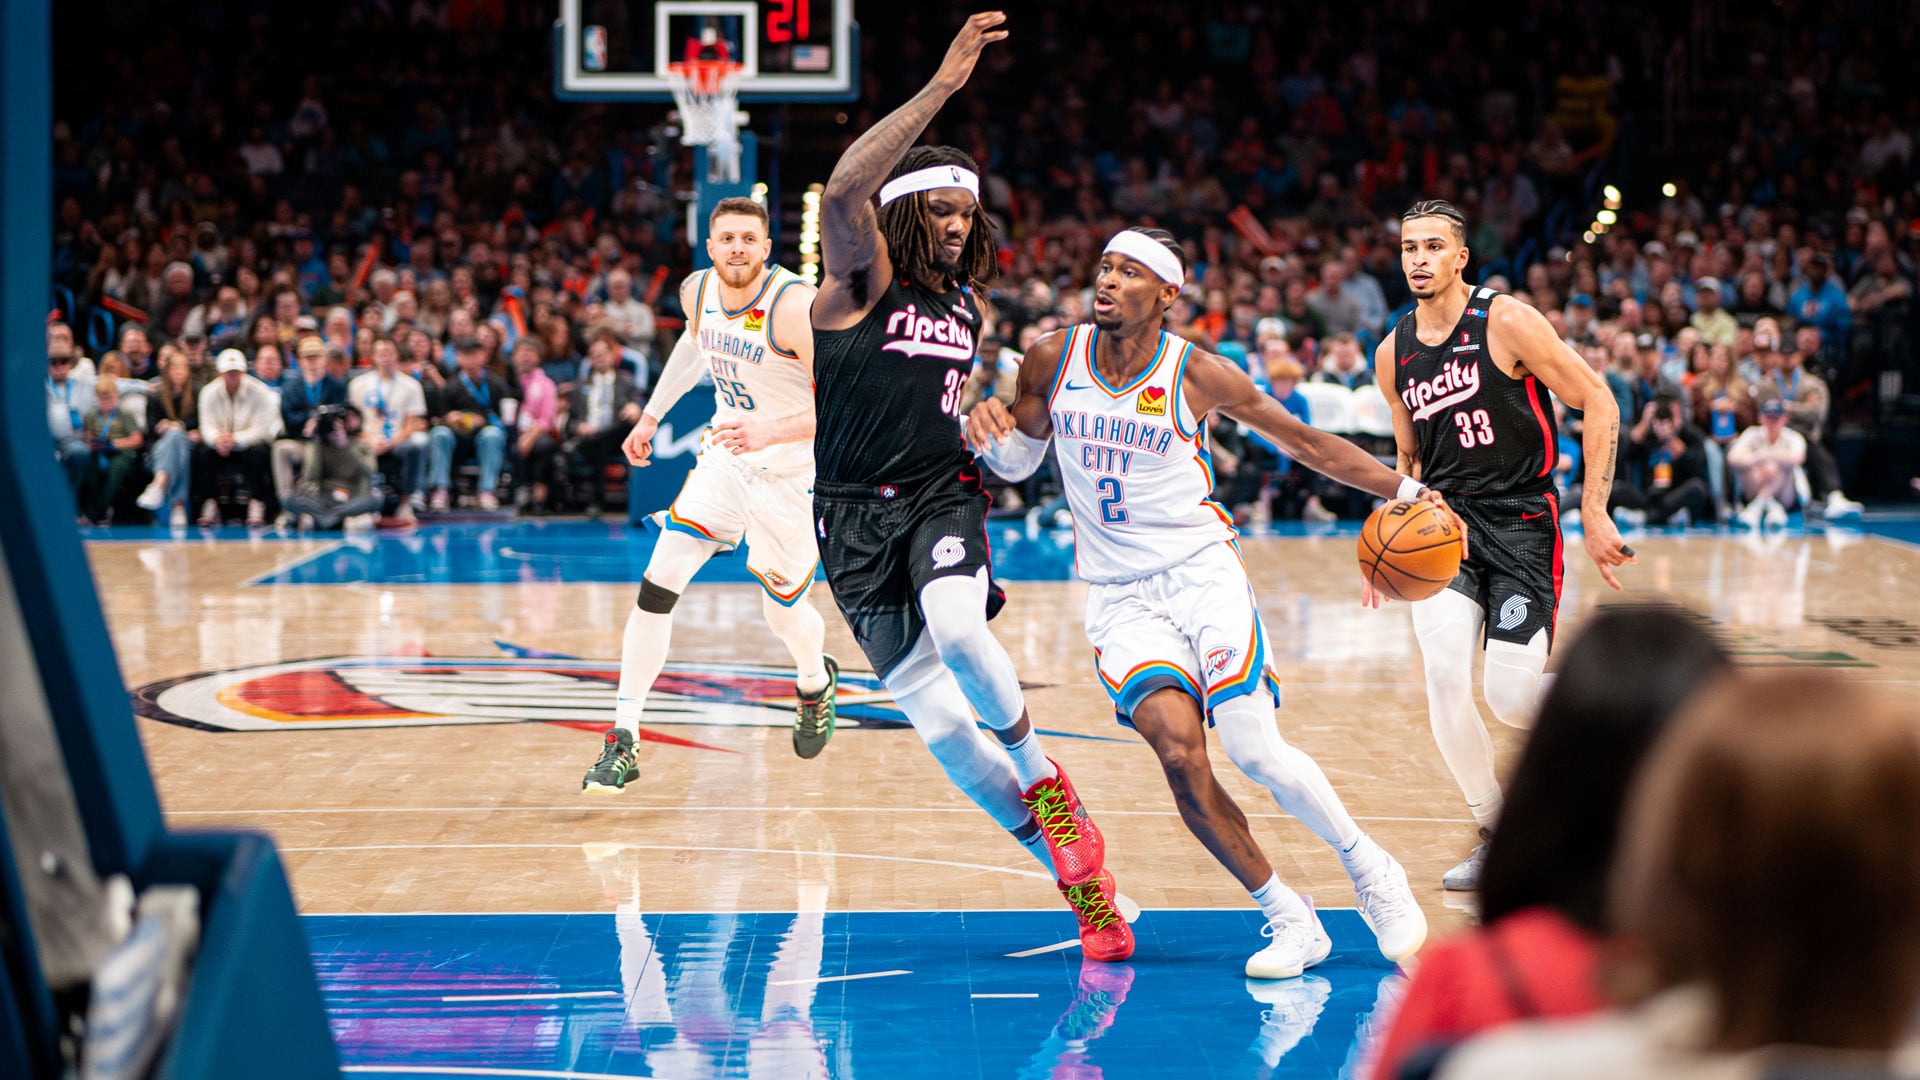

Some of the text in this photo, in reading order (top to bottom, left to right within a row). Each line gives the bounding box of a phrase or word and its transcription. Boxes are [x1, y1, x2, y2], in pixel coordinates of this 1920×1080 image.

[884, 304, 973, 360] ripcity
[711, 356, 738, 379] CITY
[716, 377, 757, 410] 55
[1401, 357, 1480, 421] ripcity
[1051, 410, 1174, 456] OKLAHOMA
[1455, 409, 1494, 448] 33
[1081, 444, 1133, 476] CITY
[1096, 475, 1129, 526] 2
